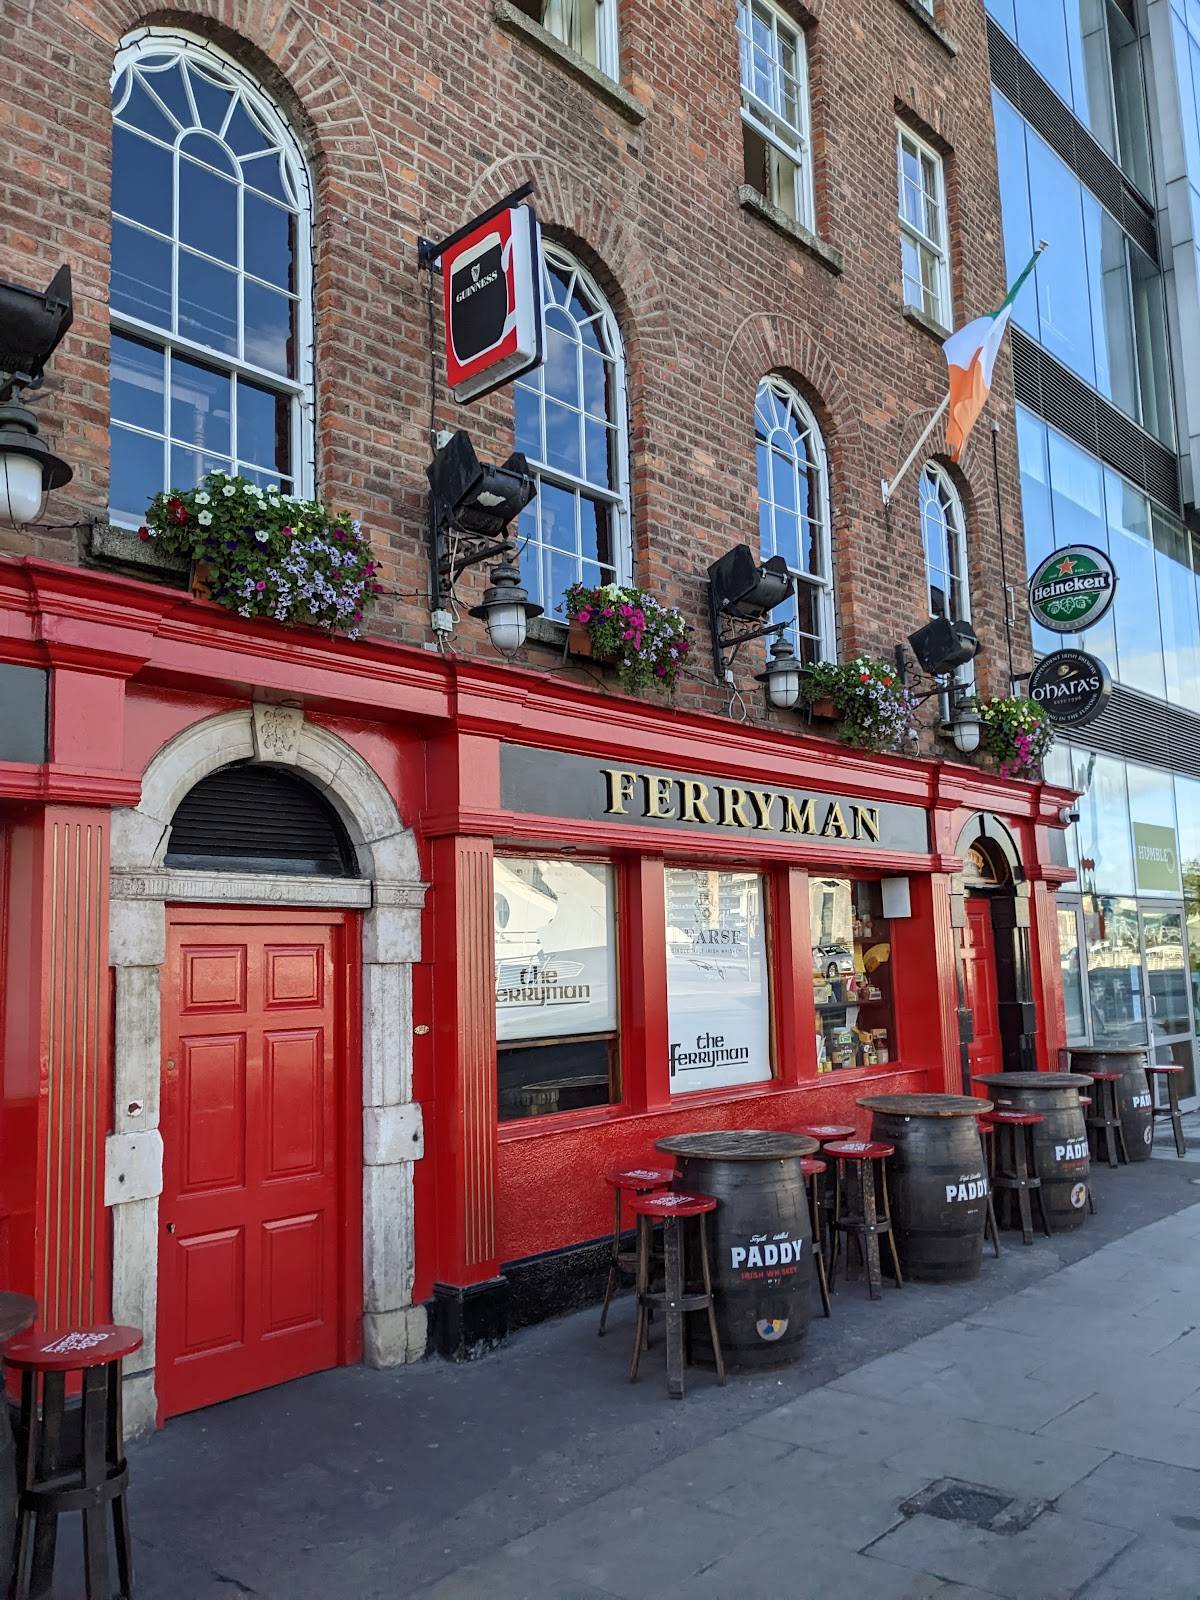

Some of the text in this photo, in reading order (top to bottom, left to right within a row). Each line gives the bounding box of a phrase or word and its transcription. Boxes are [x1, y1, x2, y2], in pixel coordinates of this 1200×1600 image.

[456, 270, 498, 303] GUINNESS
[1033, 576, 1106, 601] Heineken
[1032, 655, 1060, 687] INDEPENDENT
[1079, 655, 1097, 676] BREWERY
[600, 768, 881, 843] FERRYMAN
[1137, 845, 1169, 862] HUMBLE
[520, 965, 558, 985] the
[696, 1032, 725, 1050] the
[945, 1178, 988, 1203] PADDY
[731, 1239, 803, 1269] PADDY
[741, 1265, 799, 1280] IRISH WHSKEY
